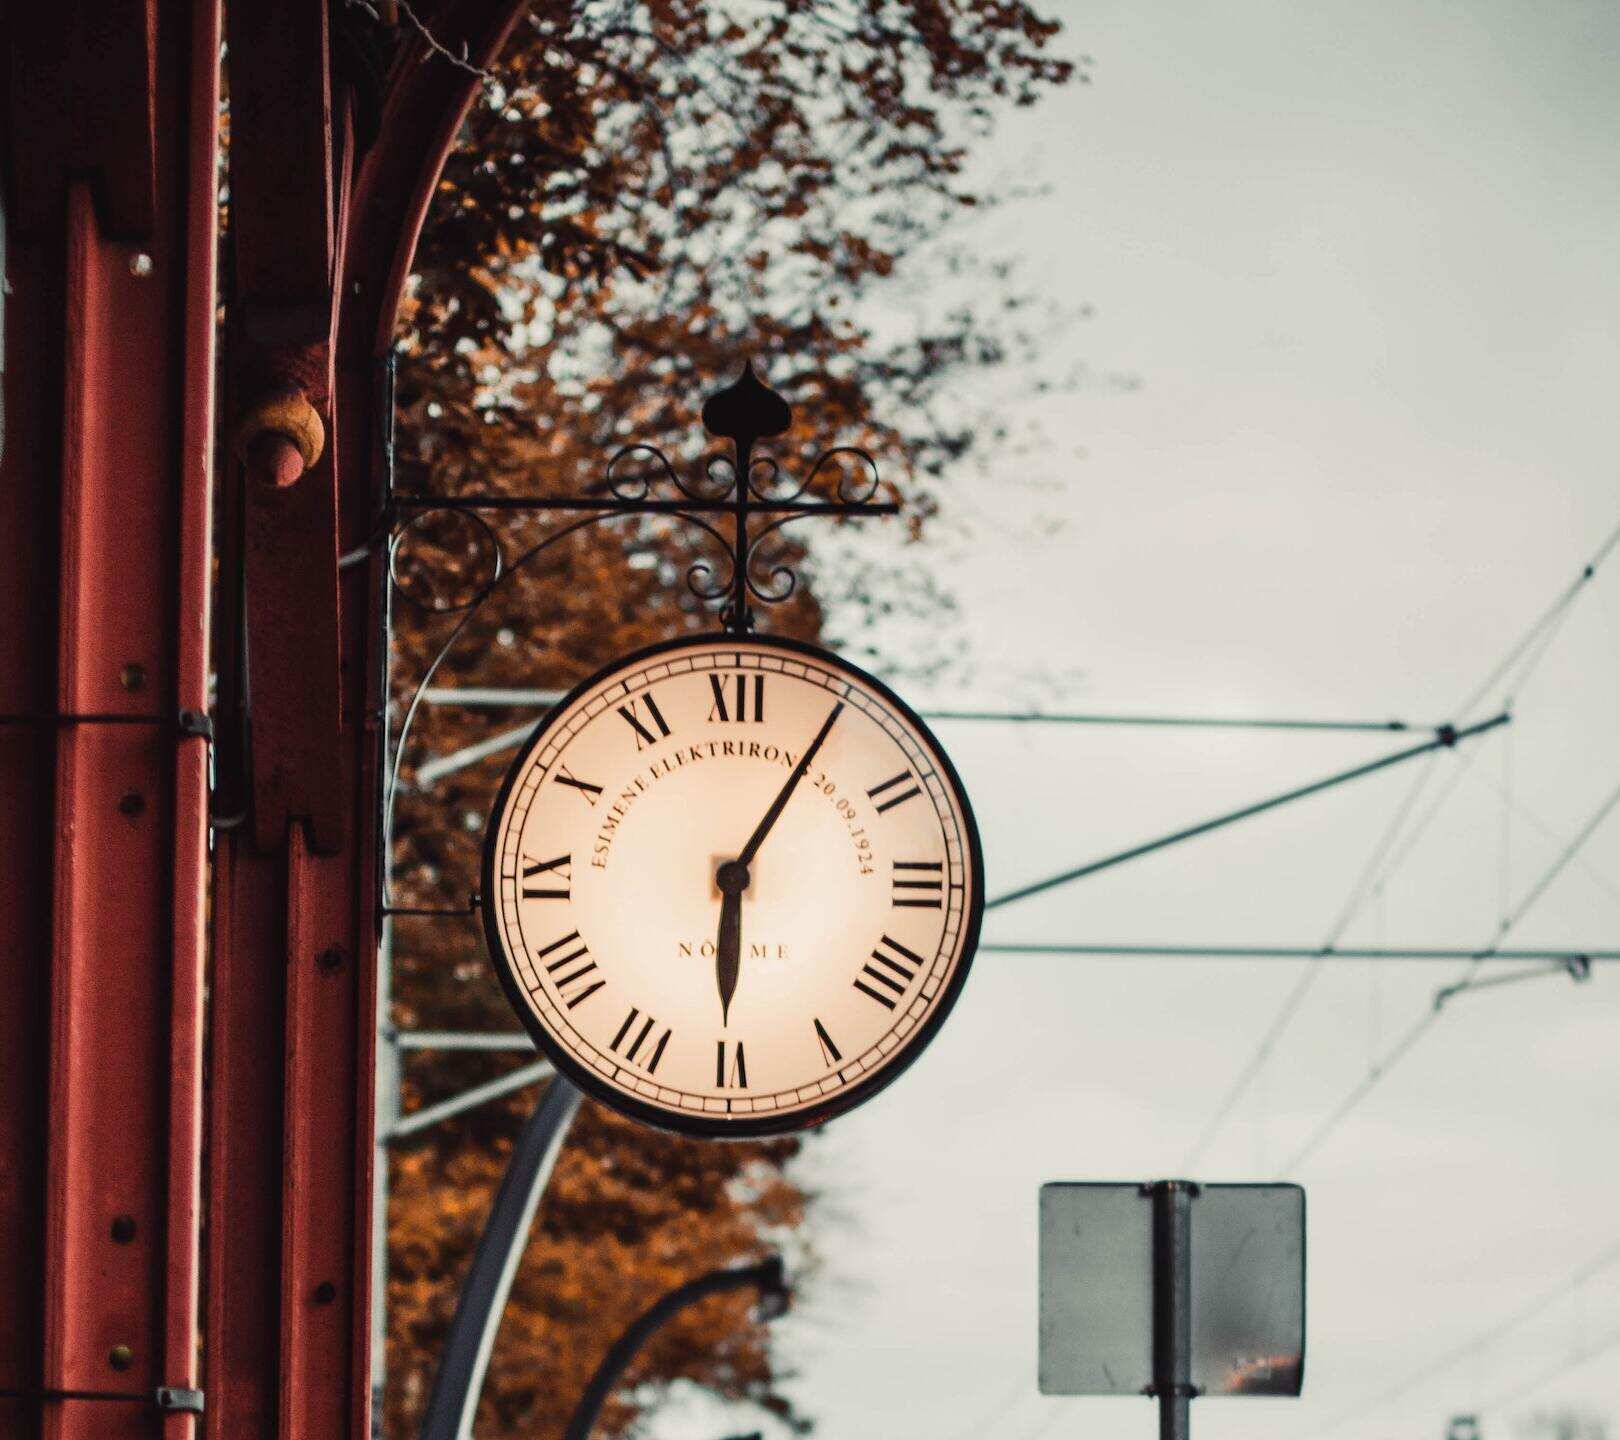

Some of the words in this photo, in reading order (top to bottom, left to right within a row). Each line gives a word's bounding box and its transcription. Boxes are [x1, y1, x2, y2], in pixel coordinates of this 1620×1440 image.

[617, 691, 672, 752] XI
[708, 674, 765, 722] XII
[553, 764, 604, 807] X
[866, 769, 923, 815] II
[591, 774, 651, 869] ESIMENE
[813, 773, 874, 876] 20.09.1924
[523, 853, 572, 901] IX
[892, 859, 943, 909] III
[536, 929, 607, 1010] VIII
[678, 938, 790, 959] NÕME
[853, 934, 925, 1012] IIII
[608, 1006, 672, 1075] VII
[716, 1040, 748, 1089] VI
[814, 1017, 843, 1068] V
